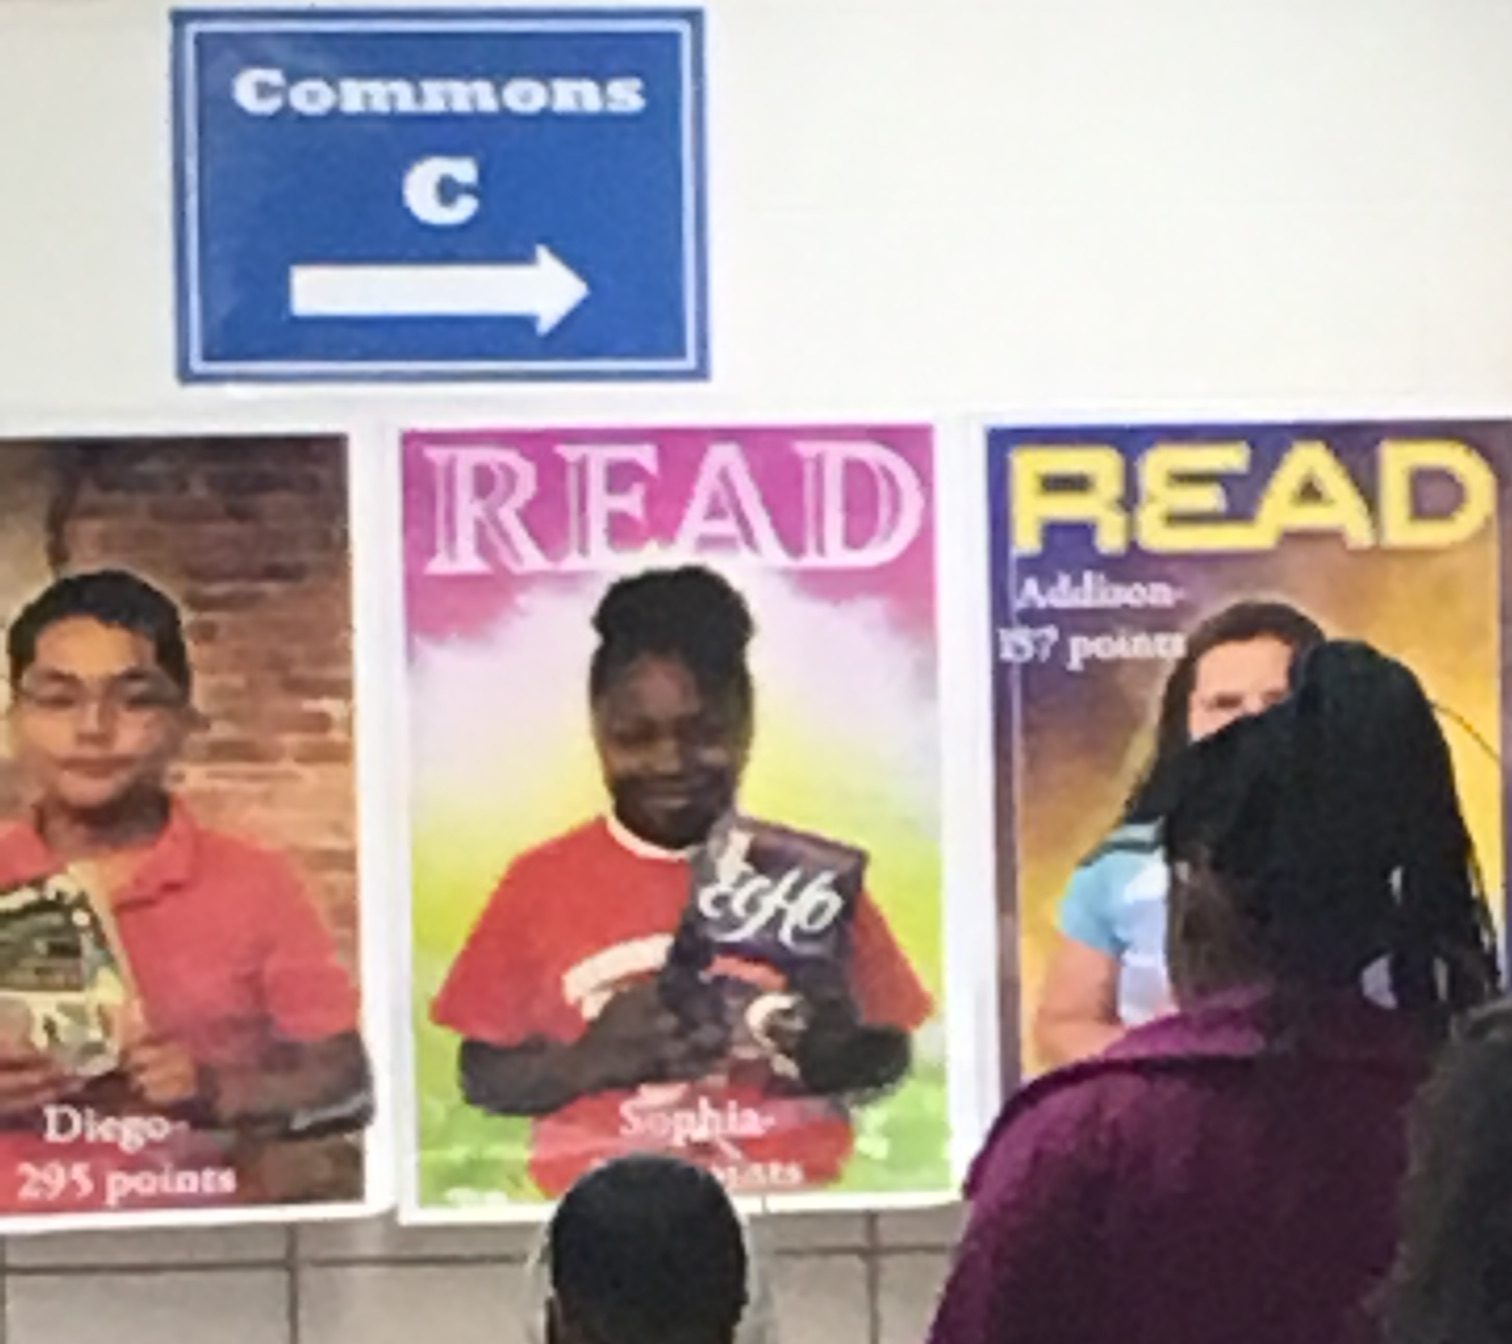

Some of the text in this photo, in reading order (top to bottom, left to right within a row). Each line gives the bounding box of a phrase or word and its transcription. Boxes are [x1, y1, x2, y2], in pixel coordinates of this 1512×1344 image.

[232, 67, 646, 116] Commons
[403, 156, 480, 226] C
[421, 440, 926, 575] READ
[1008, 439, 1498, 556] READ
[1066, 629, 1188, 671] points
[17, 1160, 237, 1206] 295 points
